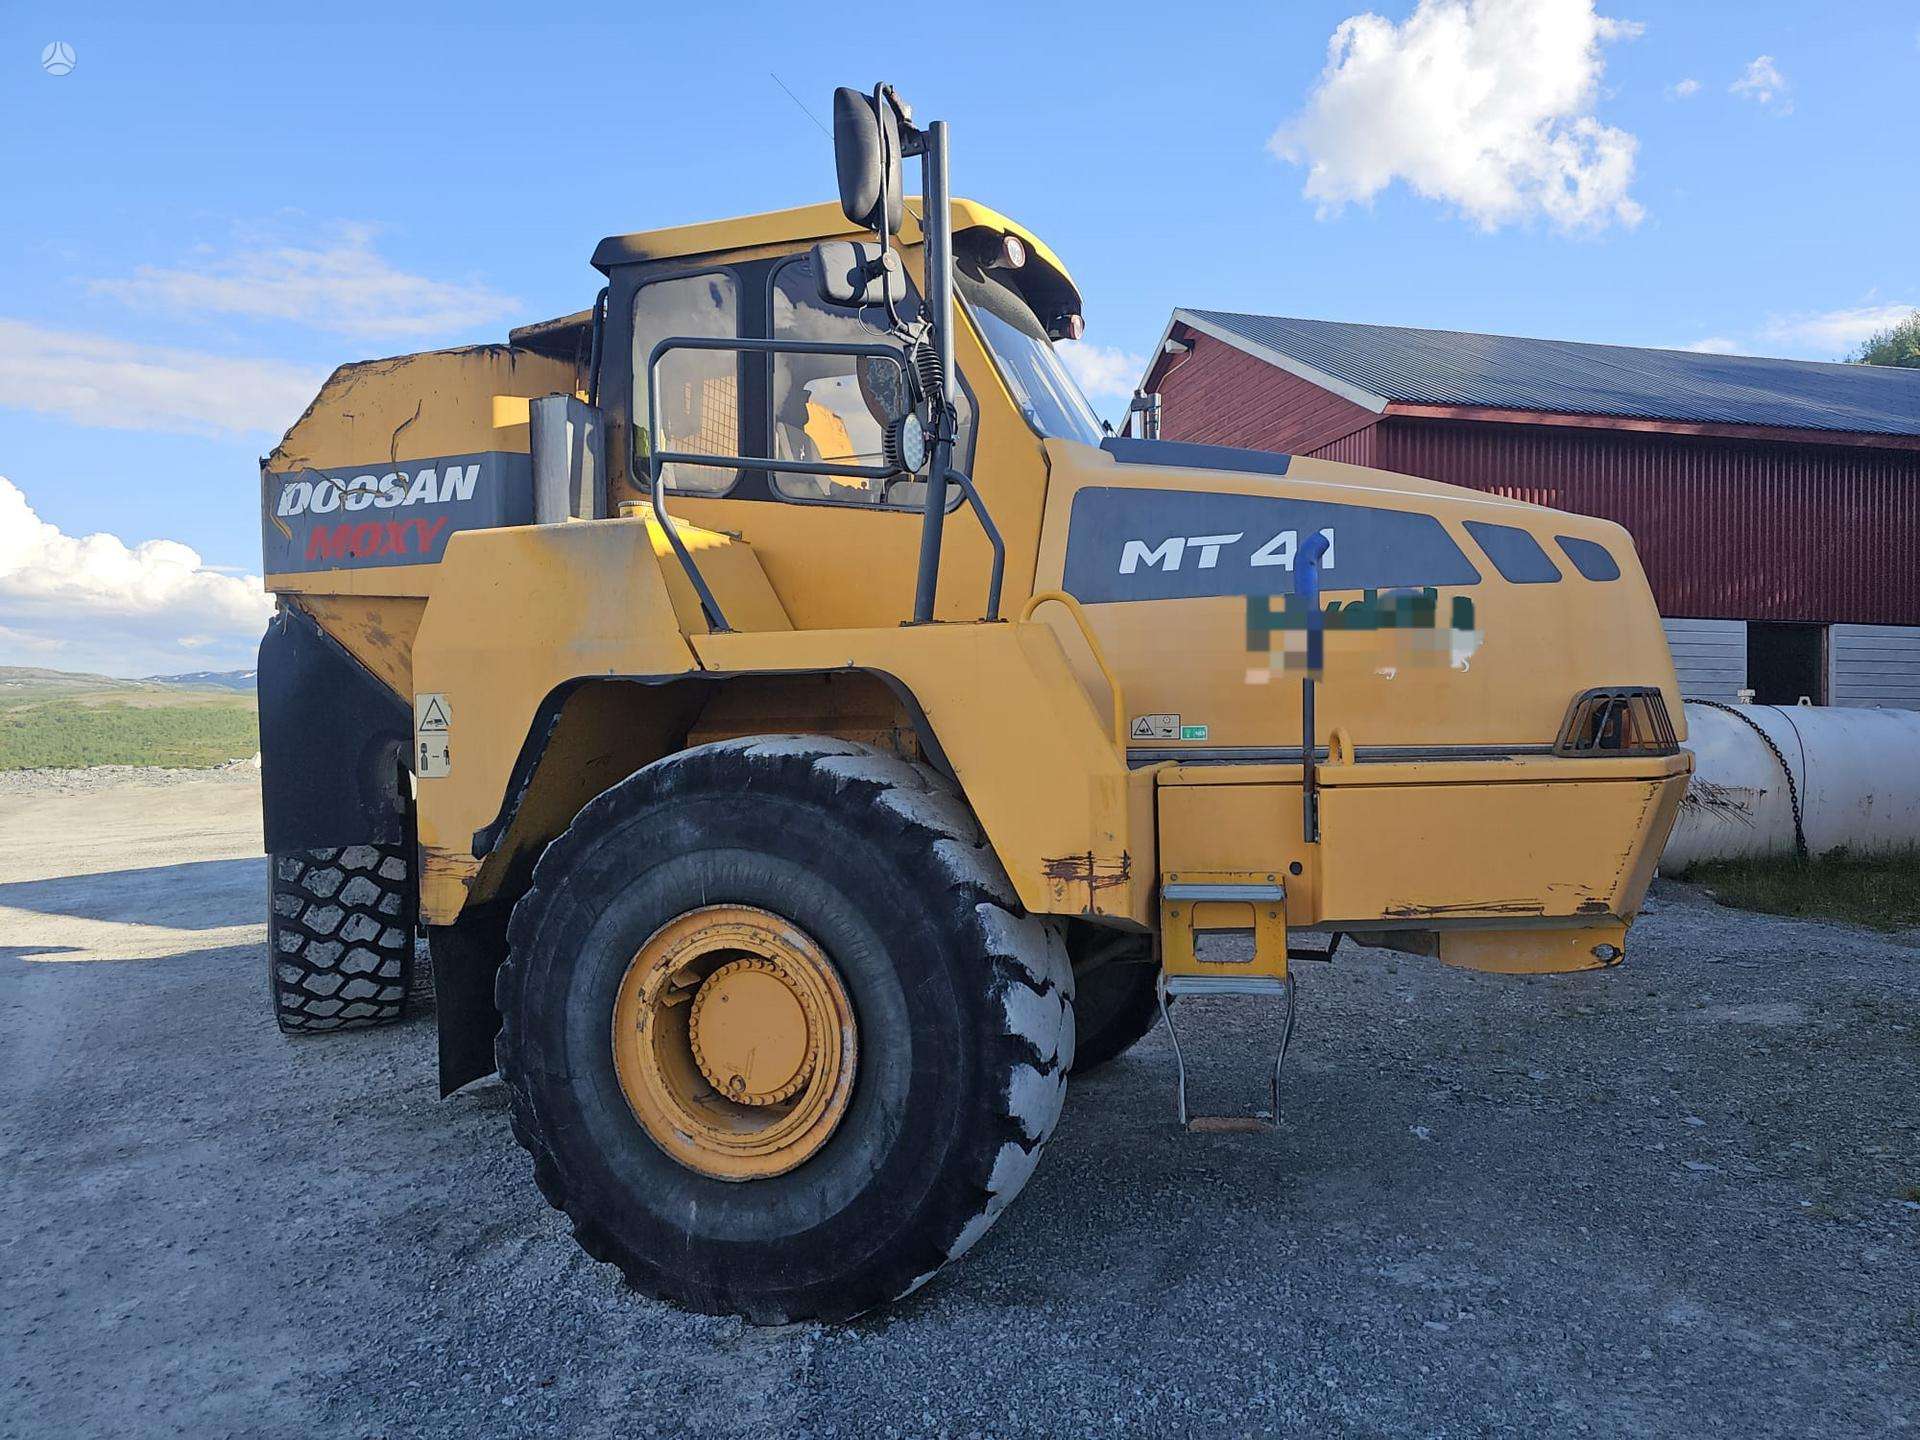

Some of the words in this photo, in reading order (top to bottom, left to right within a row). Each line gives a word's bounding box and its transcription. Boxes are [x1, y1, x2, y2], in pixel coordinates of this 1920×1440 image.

[277, 464, 481, 517] DOOSAN
[305, 516, 447, 560] MOXY
[1119, 532, 1244, 575] MT
